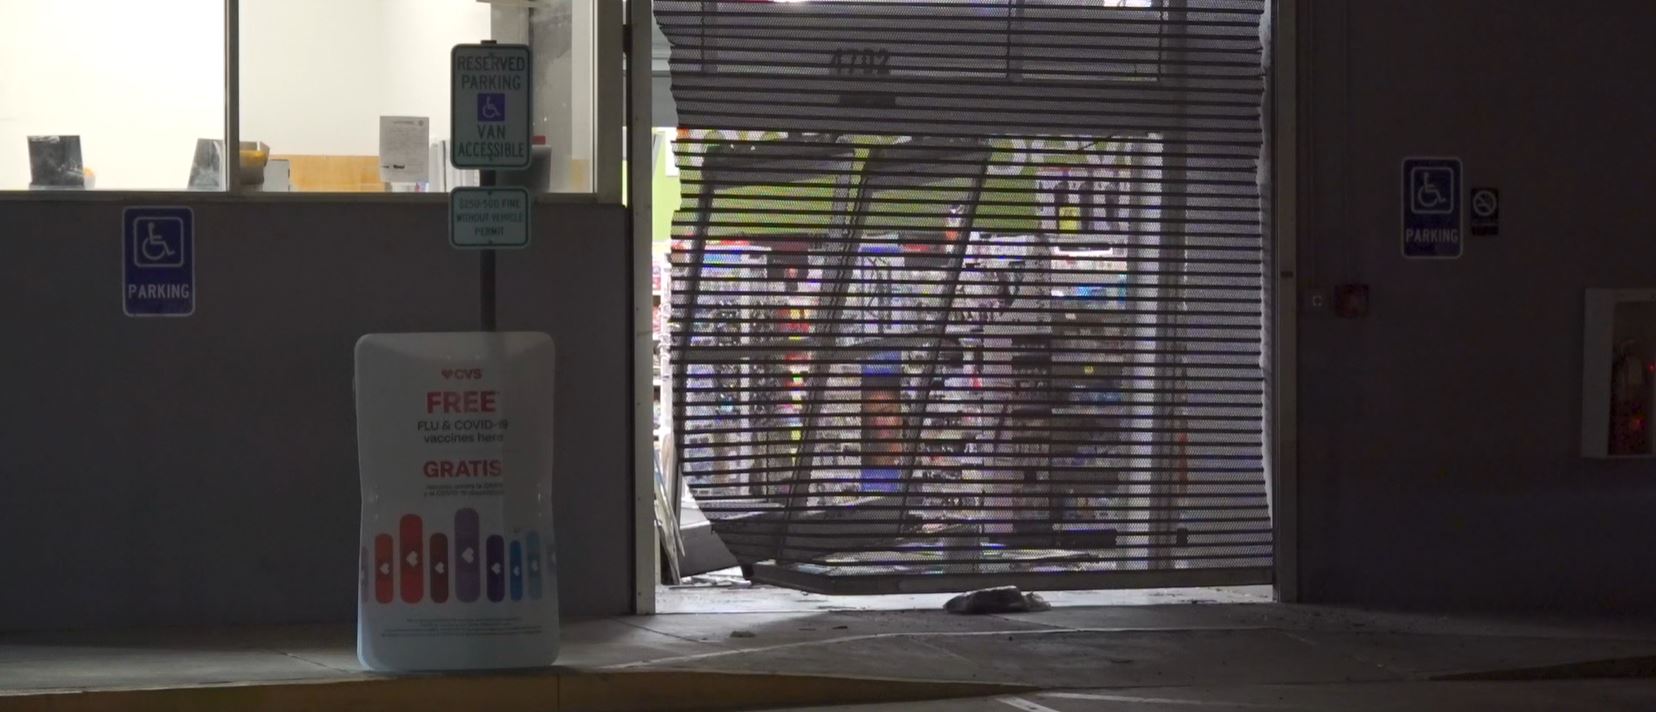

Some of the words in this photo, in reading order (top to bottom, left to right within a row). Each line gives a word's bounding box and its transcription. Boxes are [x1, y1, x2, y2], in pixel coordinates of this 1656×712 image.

[457, 56, 526, 72] RESERVED
[461, 74, 521, 90] PARKING
[477, 124, 506, 140] VAN
[457, 142, 525, 159] ACCESSIBLE
[474, 225, 504, 238] PERMIT
[1405, 228, 1459, 243] PARKING
[128, 283, 190, 299] PARKING
[454, 368, 482, 380] CVS
[426, 391, 497, 414] FREE
[417, 421, 440, 432] FLU
[442, 420, 451, 431] &
[424, 432, 475, 444] vaccines
[477, 432, 504, 443] here
[423, 459, 502, 478] GRATIS
